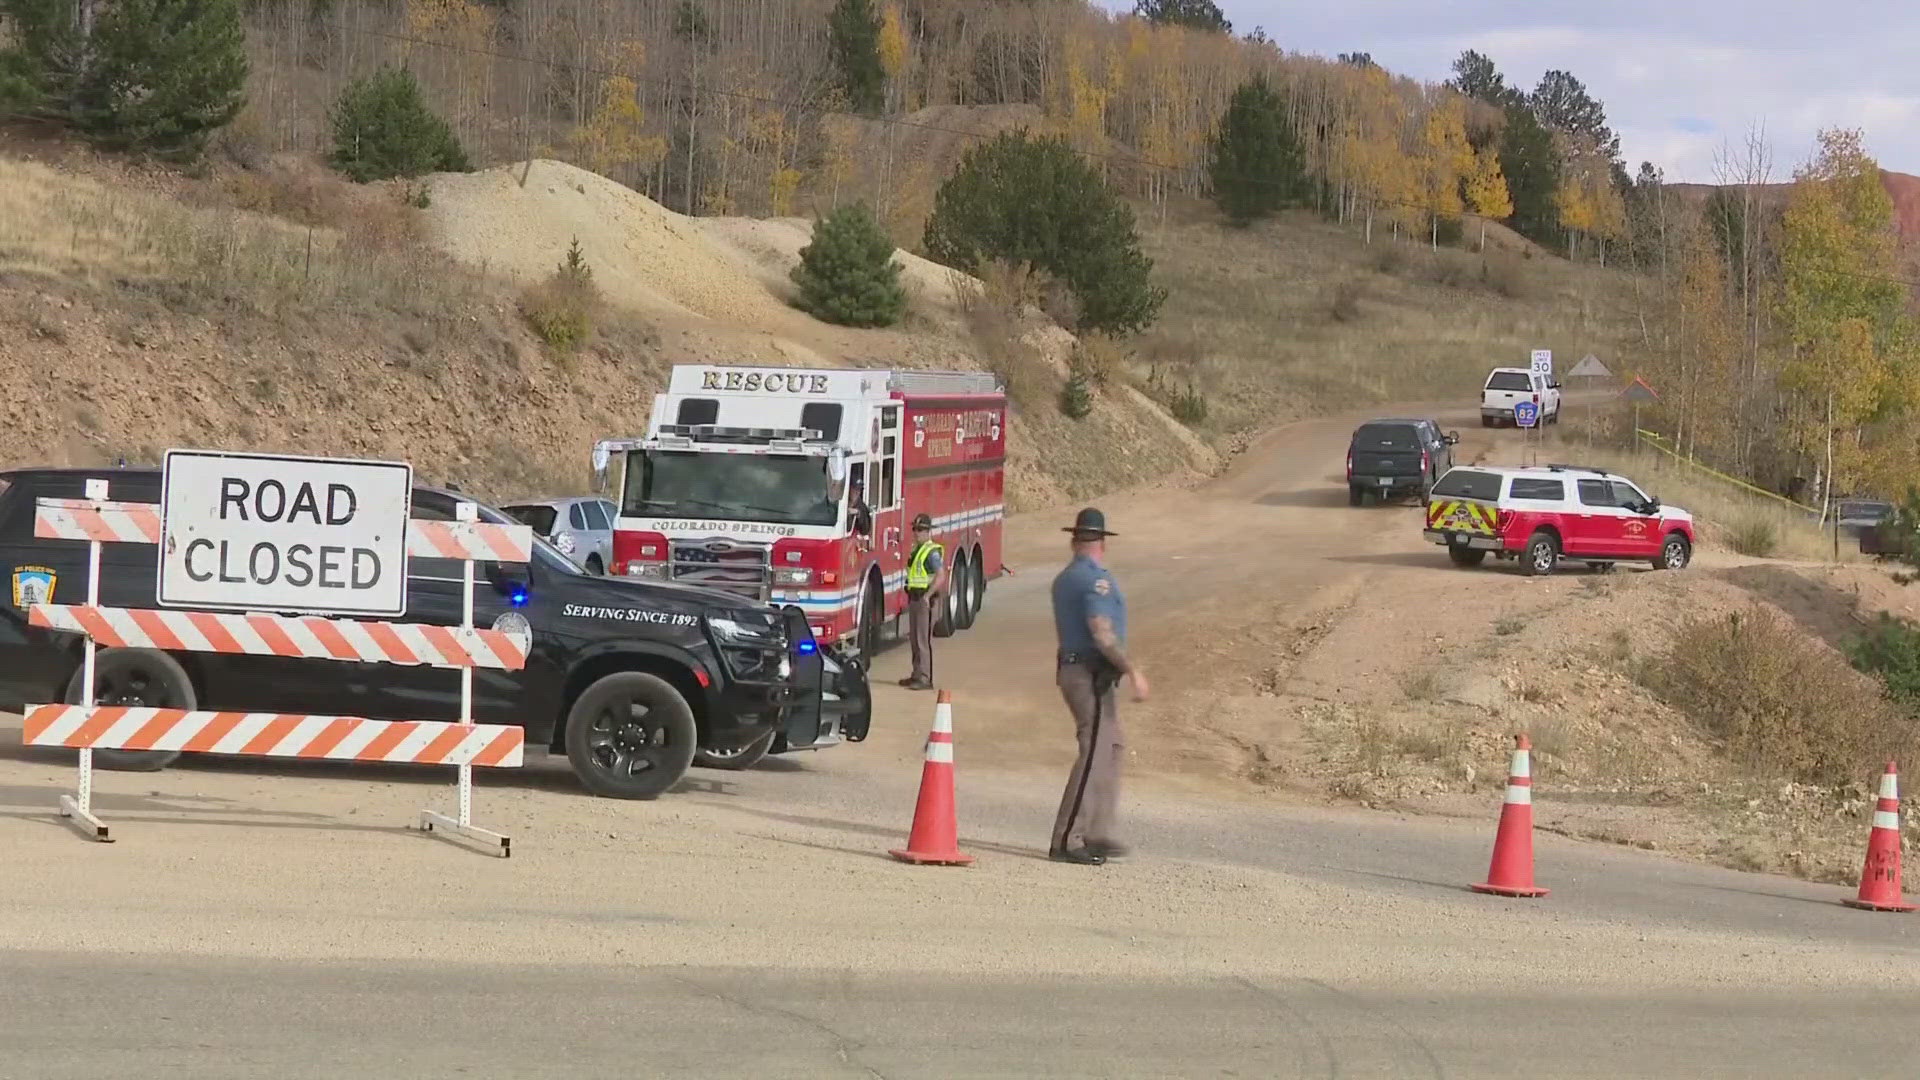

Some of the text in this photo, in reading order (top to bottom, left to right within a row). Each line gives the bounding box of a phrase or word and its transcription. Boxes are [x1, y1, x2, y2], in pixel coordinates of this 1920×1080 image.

[1533, 362, 1549, 372] 30
[701, 371, 828, 393] RESCUE
[1518, 408, 1534, 420] 82
[219, 477, 358, 526] ROAD
[652, 521, 796, 537] COLORADO SPRINGS
[184, 538, 382, 589] CLOSED
[563, 604, 698, 626] SERVING SINCE 1892
